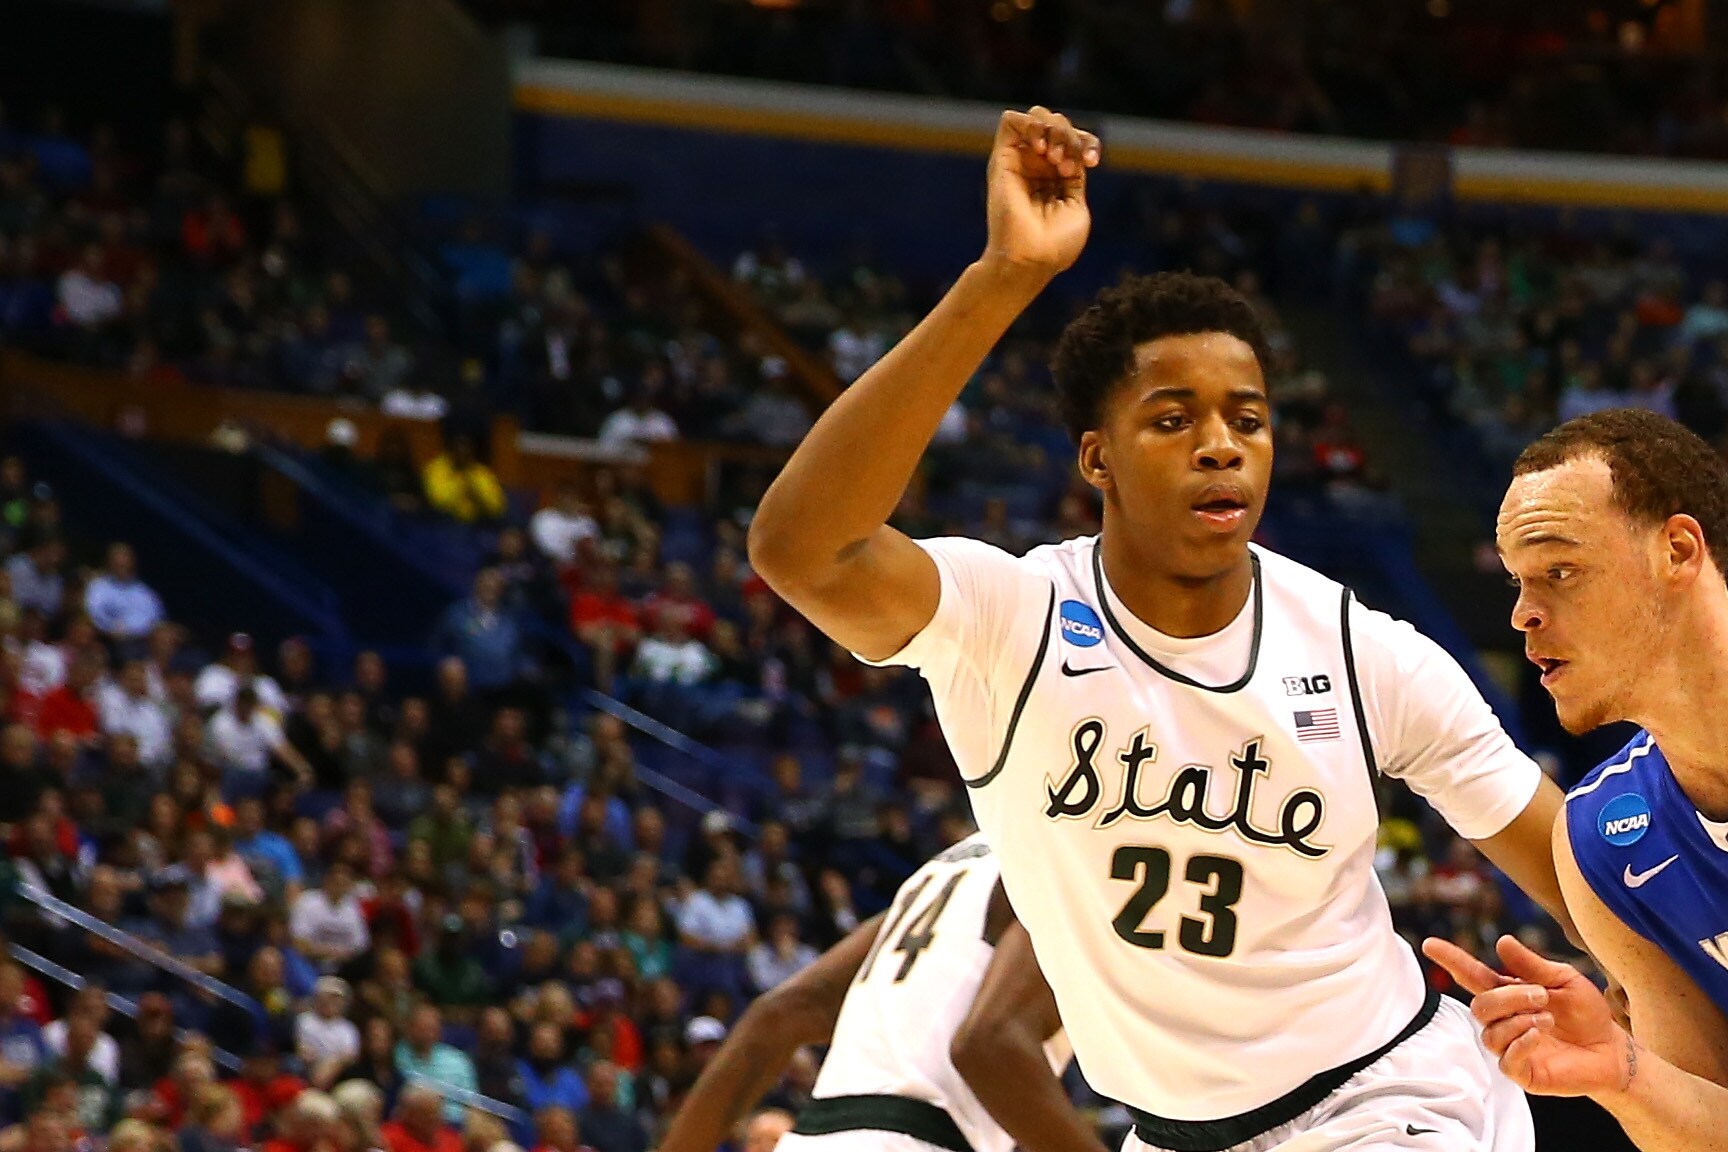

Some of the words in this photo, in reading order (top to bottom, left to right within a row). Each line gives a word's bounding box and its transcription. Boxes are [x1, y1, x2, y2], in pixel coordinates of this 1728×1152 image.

[1060, 616, 1104, 640] NCAA
[1042, 716, 1334, 861] State
[1604, 813, 1649, 836] NCAA
[1110, 845, 1243, 958] 23
